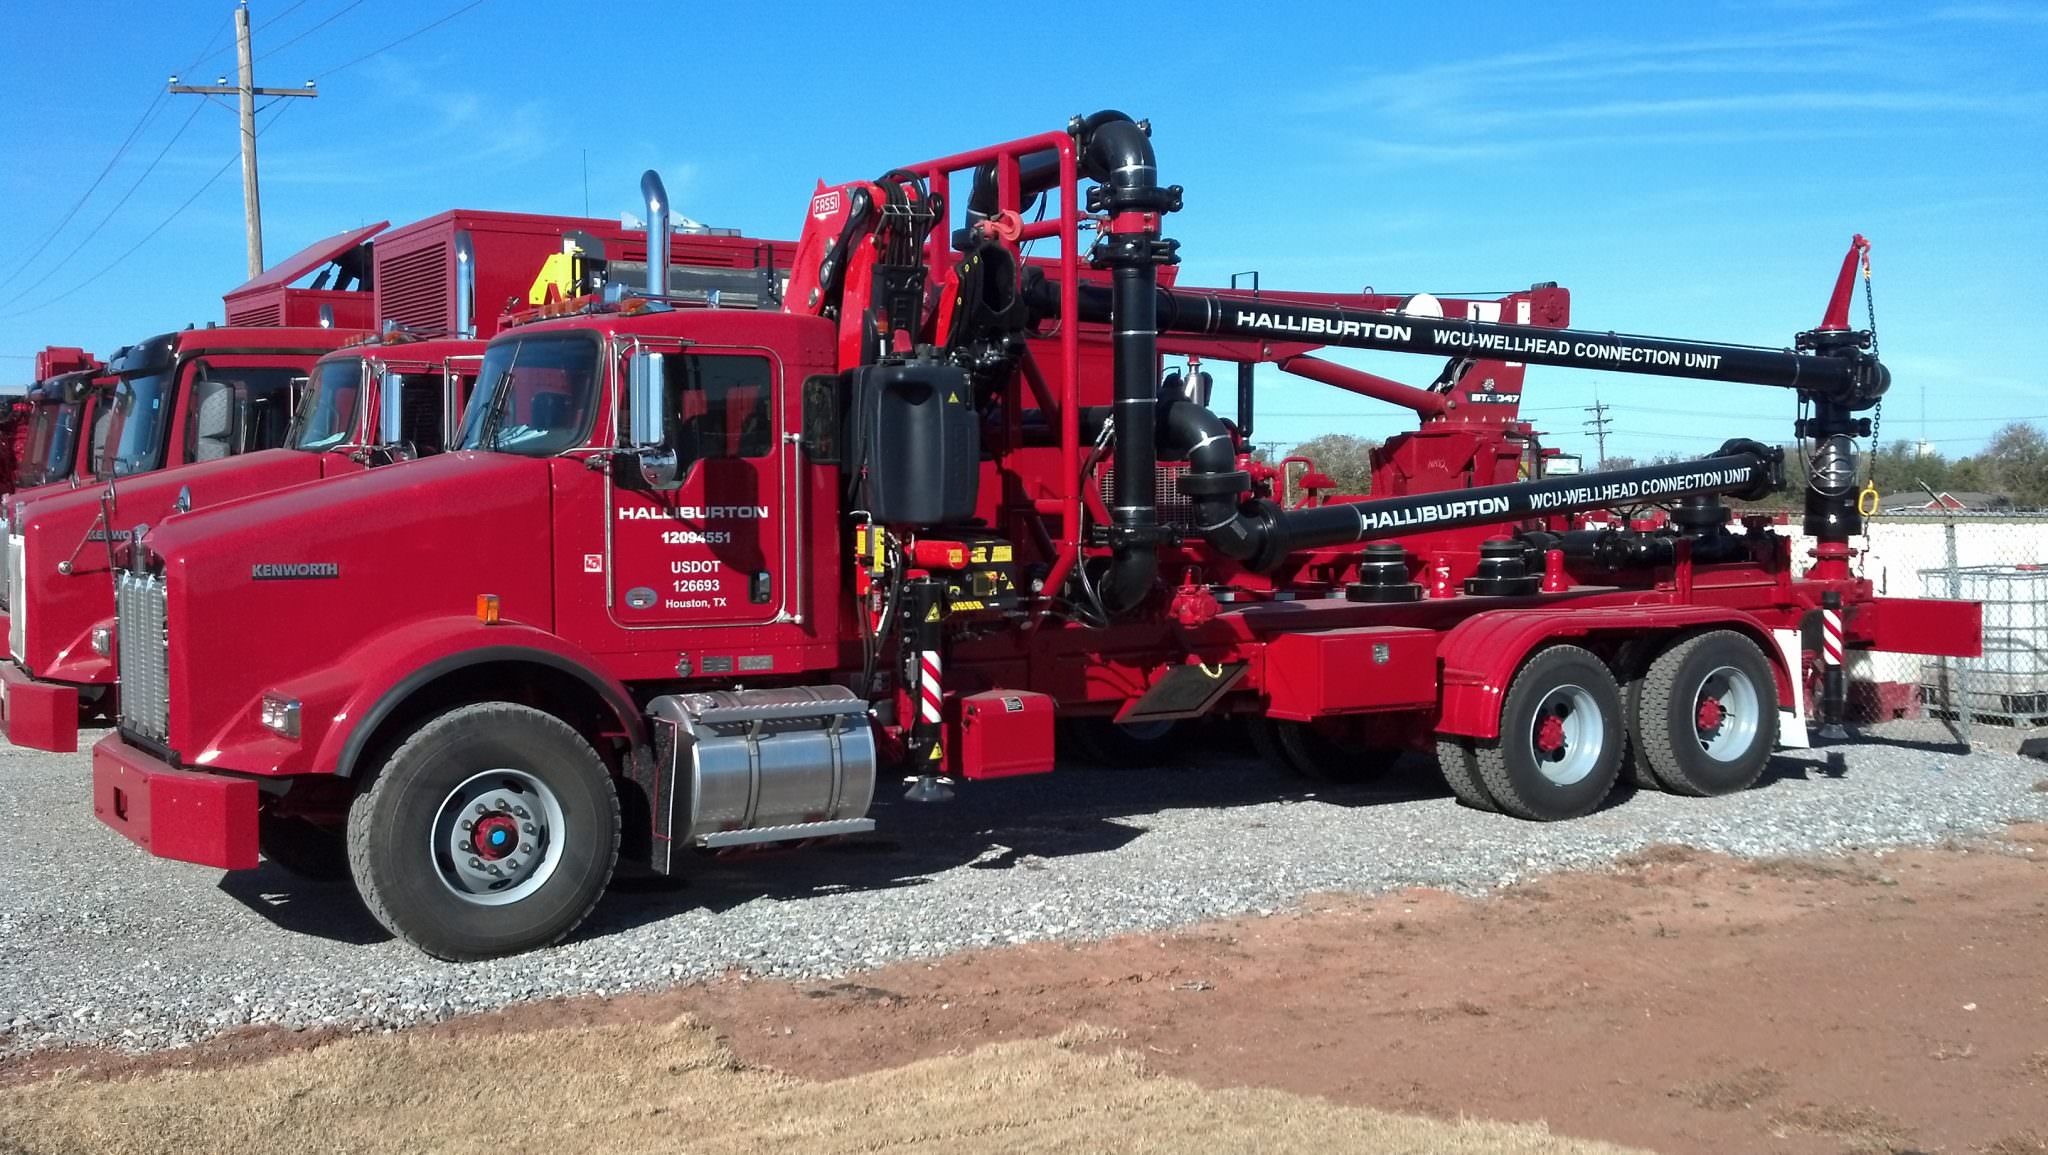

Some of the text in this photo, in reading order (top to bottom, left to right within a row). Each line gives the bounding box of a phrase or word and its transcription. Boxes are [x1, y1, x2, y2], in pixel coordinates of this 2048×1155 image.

[815, 196, 838, 213] FASSI
[1236, 311, 1722, 370] HALLIBURTON WCU-WELLHEAD CONNECTION UNIT
[1362, 467, 1752, 530] HALLIBURTON WCU-WELLHEAD CONNECTION UNIT
[619, 506, 769, 520] HALLIBURTON
[661, 531, 731, 544] 12094551
[252, 563, 338, 577] KENWORTH
[671, 560, 721, 574] USDOT
[672, 579, 720, 592] 126693
[665, 598, 711, 609] Houston,
[712, 597, 727, 607] TX
